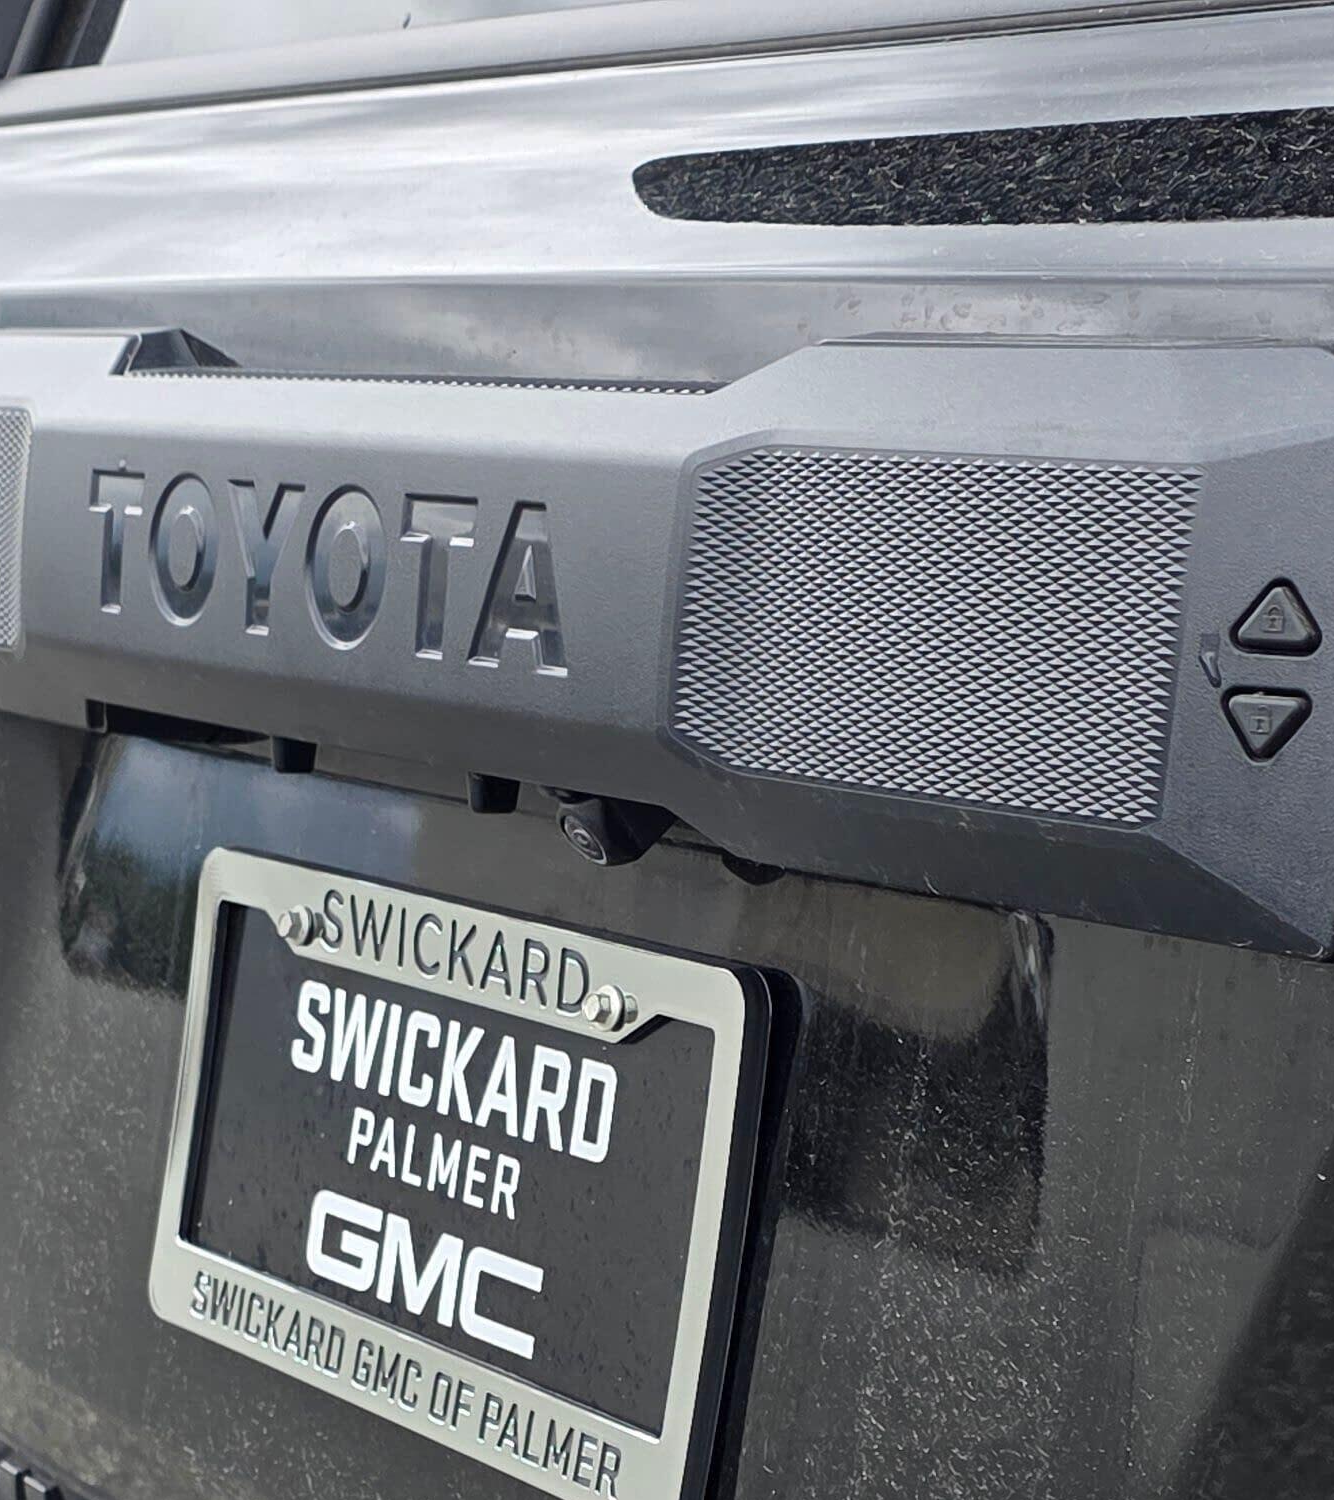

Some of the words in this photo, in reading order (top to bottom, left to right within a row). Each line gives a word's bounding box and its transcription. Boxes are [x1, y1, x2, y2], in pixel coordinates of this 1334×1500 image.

[89, 467, 569, 678] TOYOTA
[320, 888, 593, 1018] SWICKARD
[290, 979, 619, 1164] SWICKARD
[346, 1107, 521, 1221] PALMER
[190, 1270, 348, 1376] SWICKARD
[351, 1339, 423, 1414] GMC
[428, 1370, 476, 1431] OF
[306, 1188, 544, 1361] GMC
